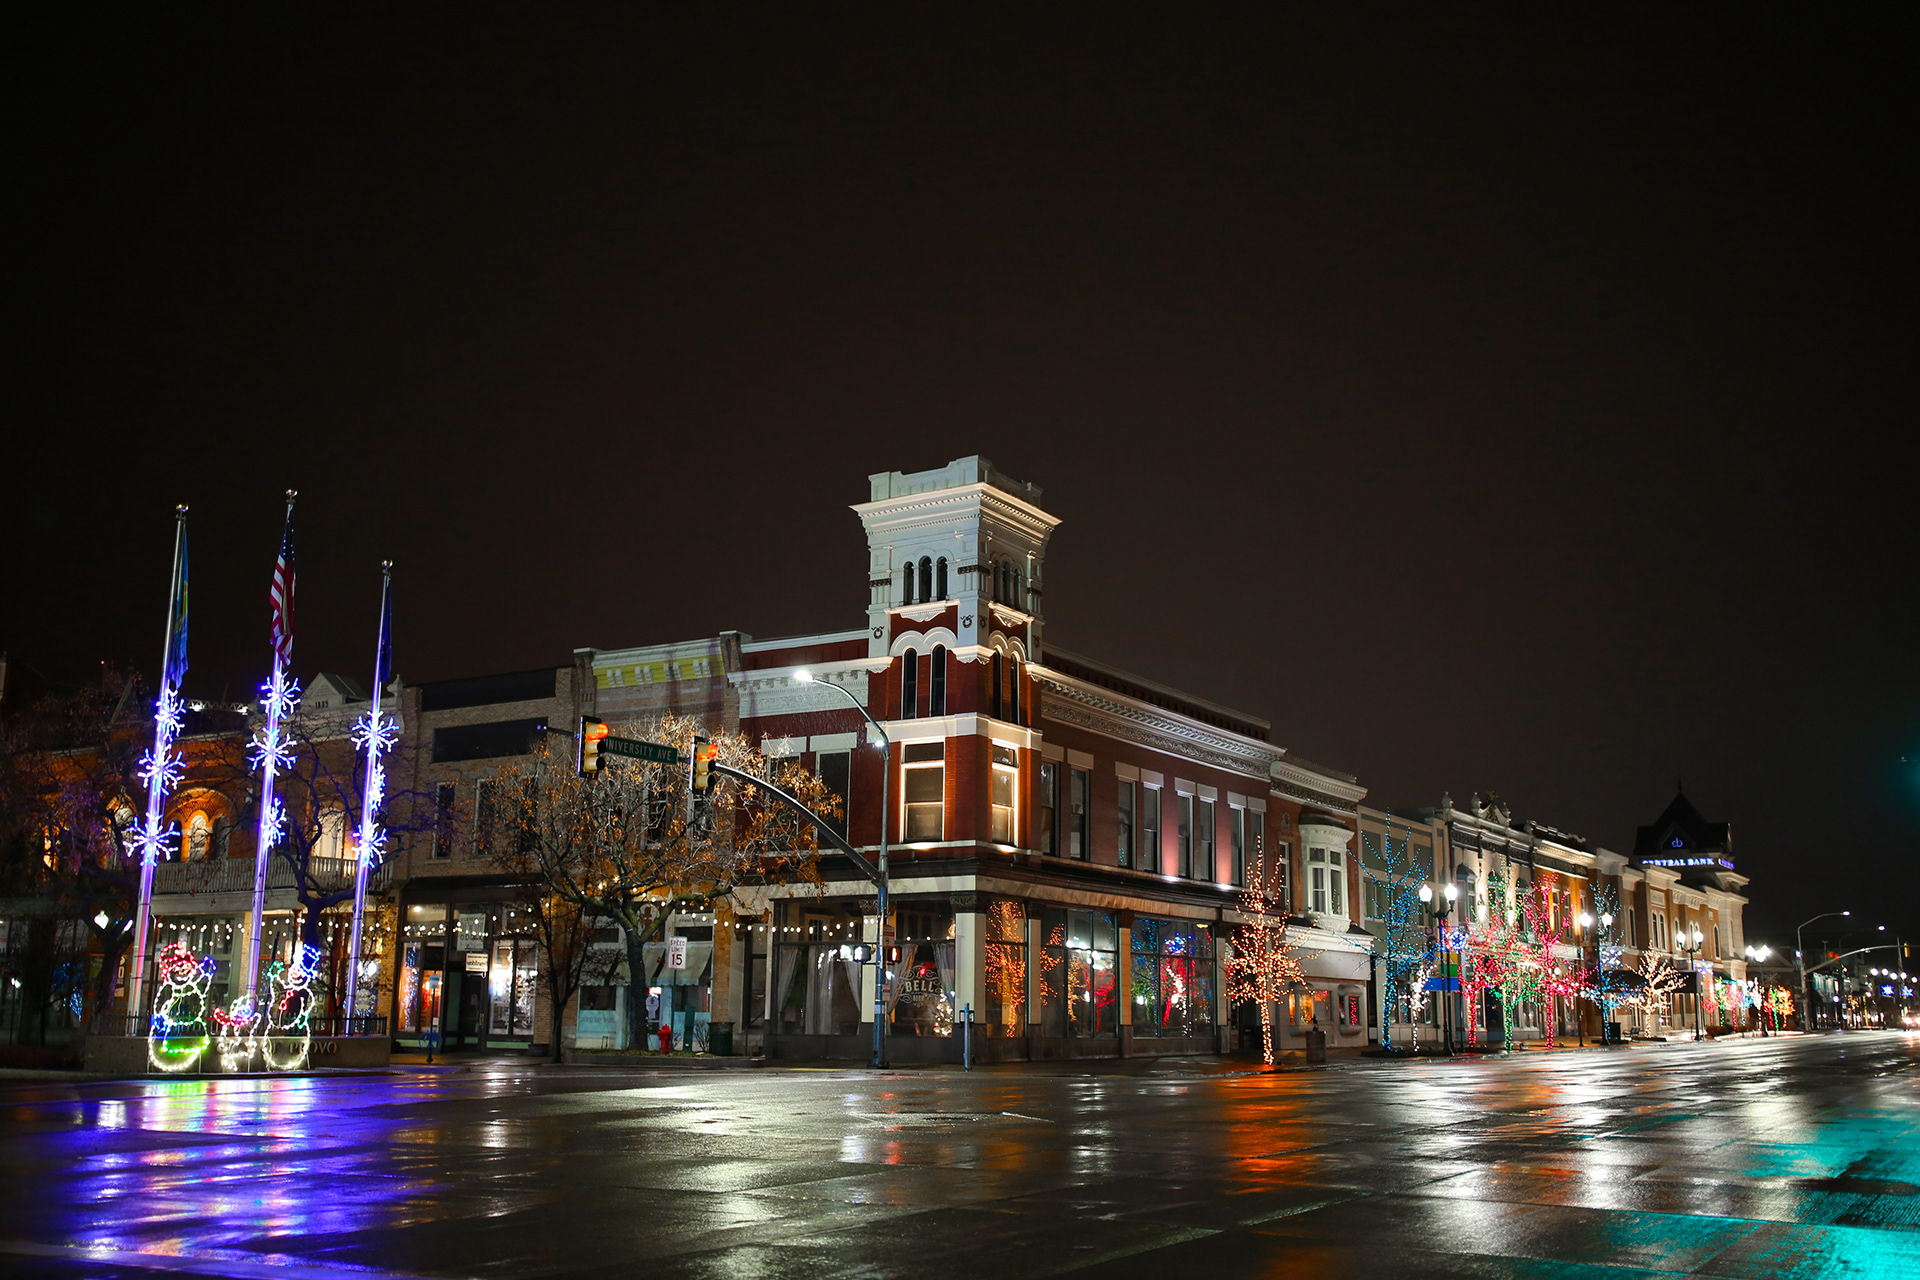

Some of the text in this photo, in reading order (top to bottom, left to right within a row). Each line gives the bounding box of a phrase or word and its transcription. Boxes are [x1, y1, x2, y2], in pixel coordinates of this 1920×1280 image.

[1687, 857, 1715, 866] BANK
[671, 953, 683, 966] 15
[905, 980, 934, 992] BELL
